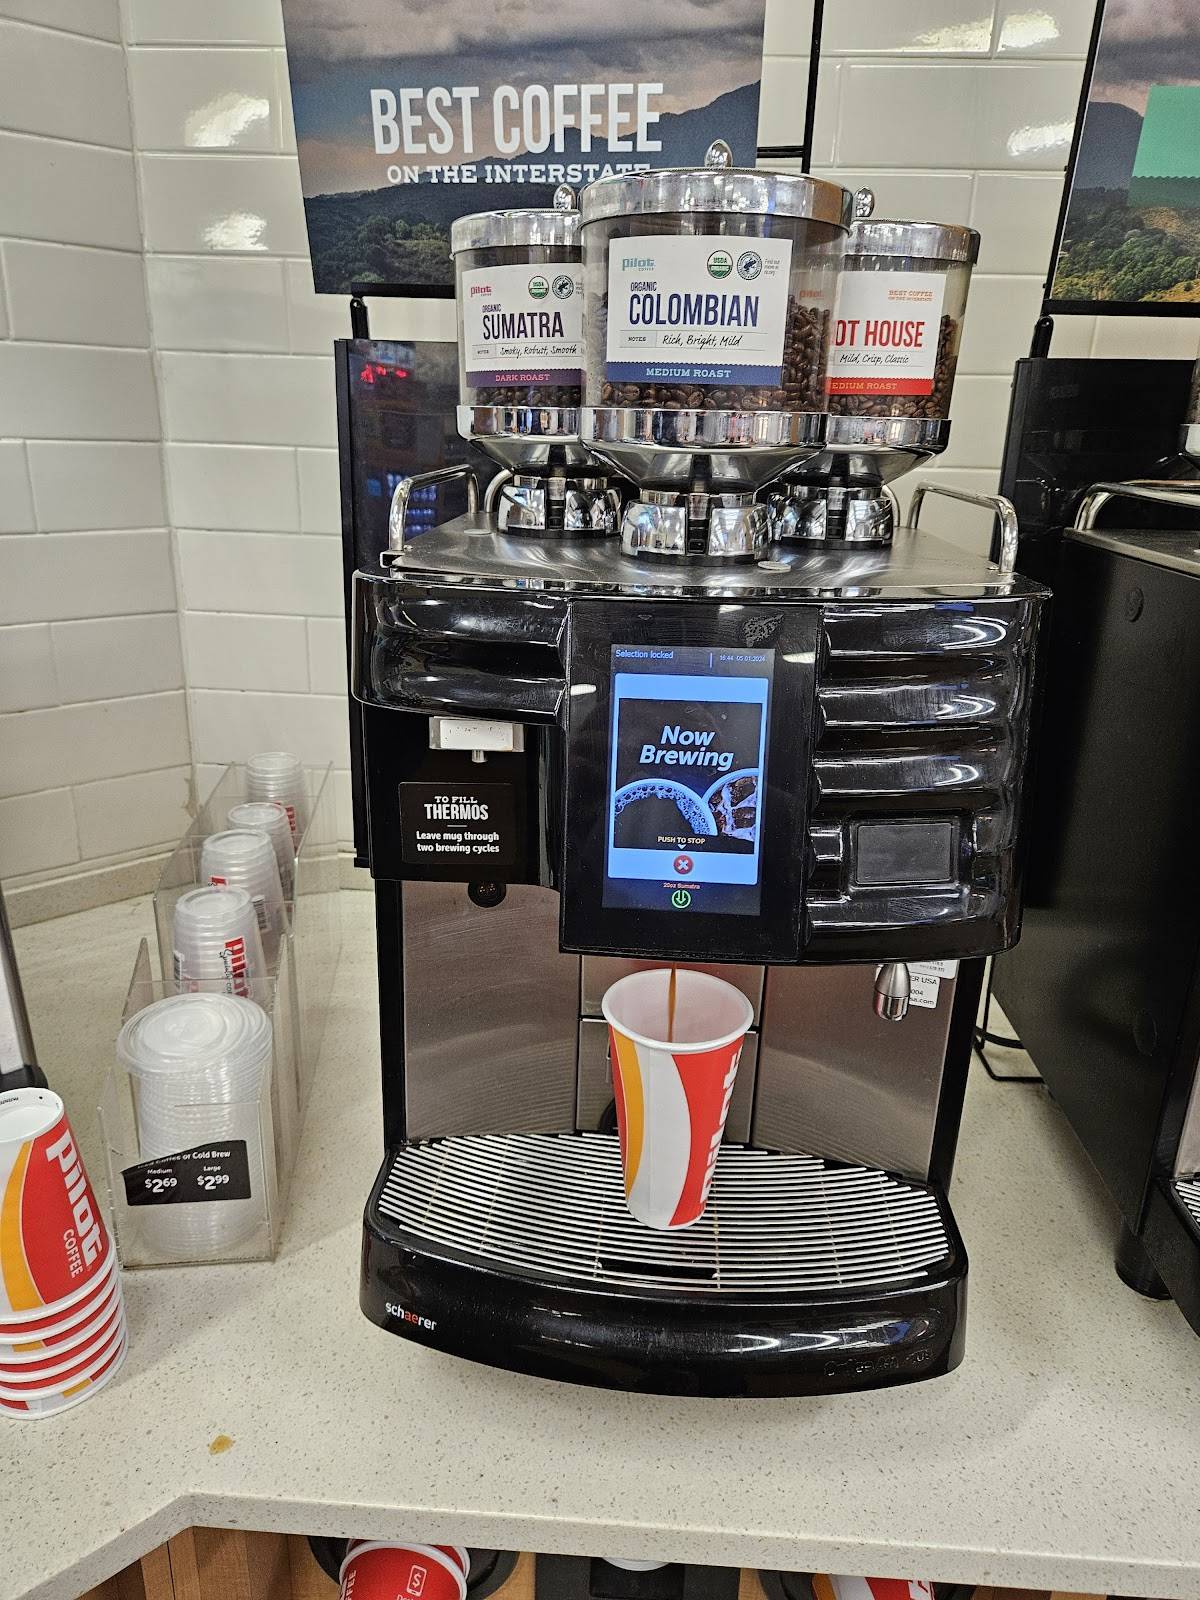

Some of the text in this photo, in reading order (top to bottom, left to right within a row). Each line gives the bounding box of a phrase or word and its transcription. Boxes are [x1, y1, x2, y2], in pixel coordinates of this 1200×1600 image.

[370, 83, 664, 154] BEST COFFEE
[387, 165, 420, 184] ON
[426, 165, 477, 183] THE
[622, 258, 655, 271] pilot
[631, 281, 657, 292] ORGANIC
[482, 304, 502, 313] ORGANIC
[629, 293, 760, 328] COLOMBIAN
[482, 312, 564, 340] SUMATRA
[662, 332, 743, 350] Rich, Bright, Mild
[835, 320, 925, 348] OT HOUSE
[500, 344, 577, 359] Smoky, Robust, Smooth
[840, 354, 909, 366] Mild, Crisp, Classic
[495, 373, 551, 382] DARK ROAST
[646, 368, 731, 378] MEDIUM ROAST
[832, 382, 864, 390] EDIUM
[616, 650, 674, 659] Selection locked
[660, 725, 716, 746] Now
[639, 745, 734, 771] Brewing
[451, 796, 478, 804] FILL
[424, 804, 489, 821] THERMOS
[416, 831, 500, 843] Leave mug through
[687, 837, 706, 845] STOP
[417, 843, 500, 855] two brewing cycles
[922, 977, 937, 985] USA
[192, 1151, 210, 1160] Cold
[211, 1150, 231, 1158] Brew
[147, 1167, 172, 1175] Medium
[144, 1177, 177, 1193] $269
[197, 1174, 230, 1190] $299
[46, 1129, 103, 1266] pilot
[63, 1229, 83, 1279] COFFEE
[385, 1302, 438, 1331] schaerer
